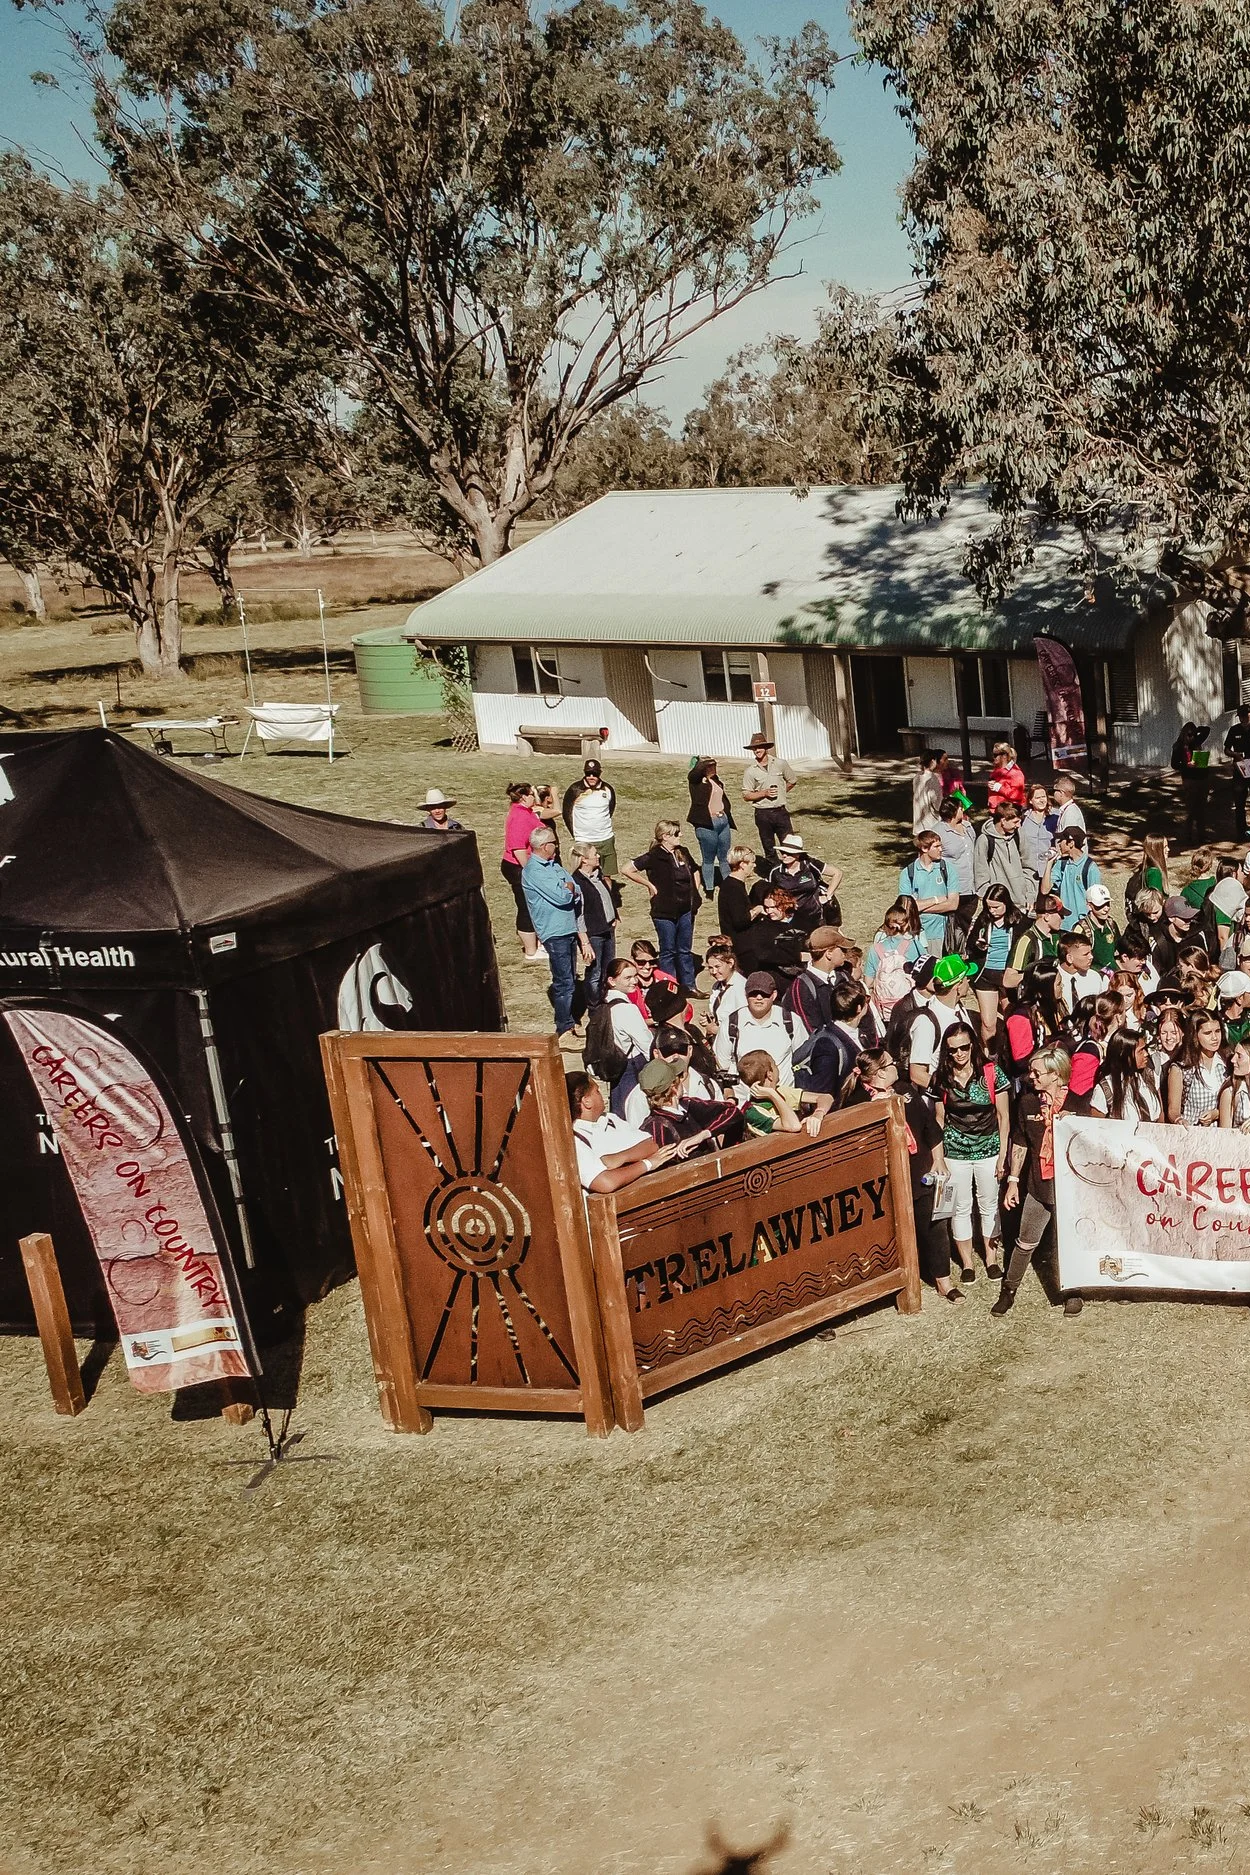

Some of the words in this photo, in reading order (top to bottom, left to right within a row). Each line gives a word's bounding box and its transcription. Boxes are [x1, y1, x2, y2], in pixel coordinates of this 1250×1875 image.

[760, 688, 770, 697] 12
[53, 946, 136, 967] Health
[32, 1046, 123, 1150] CAREERS
[116, 1161, 150, 1199] ON
[145, 1206, 228, 1310] COUNTRY
[1146, 1210, 1182, 1228] on
[624, 1175, 888, 1313] TRELAWNEY
